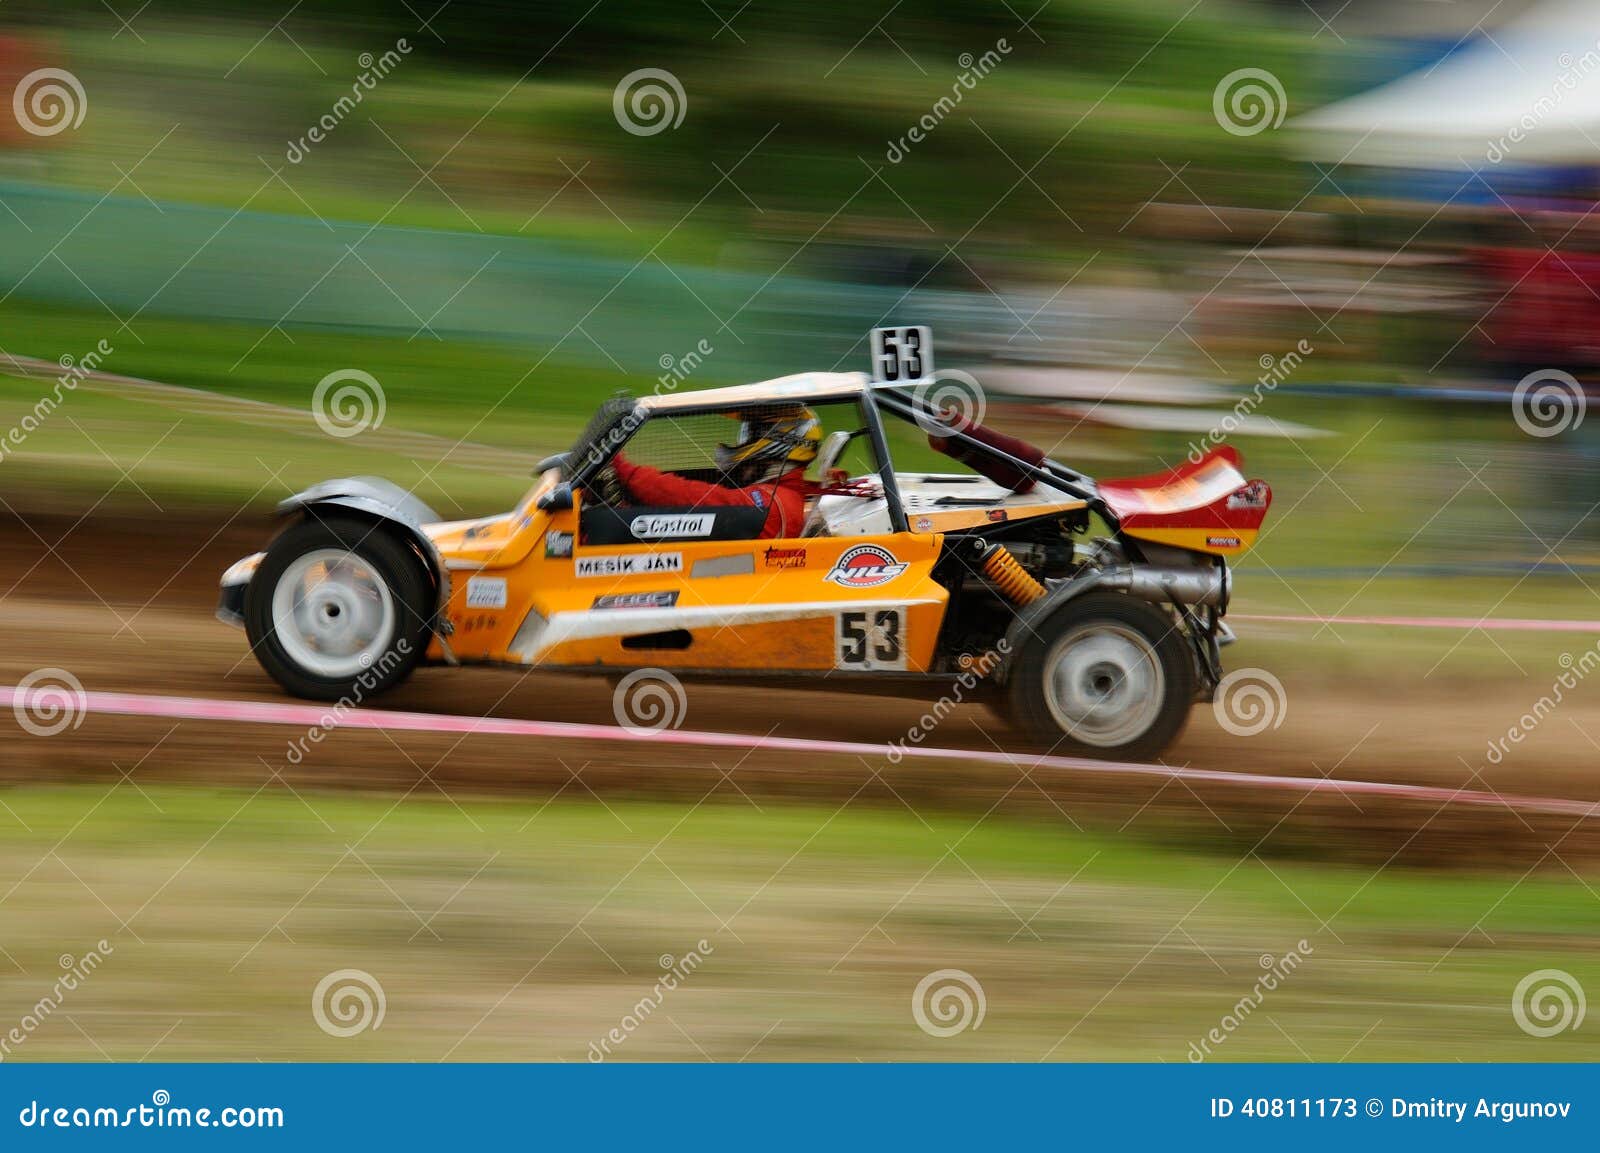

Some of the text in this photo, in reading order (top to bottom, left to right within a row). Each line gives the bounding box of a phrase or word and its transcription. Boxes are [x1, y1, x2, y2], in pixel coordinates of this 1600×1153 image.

[882, 328, 922, 381] 53
[650, 518, 704, 533] Castrol
[644, 552, 679, 570] JÁN
[825, 564, 909, 580] NILS
[842, 610, 900, 663] 53
